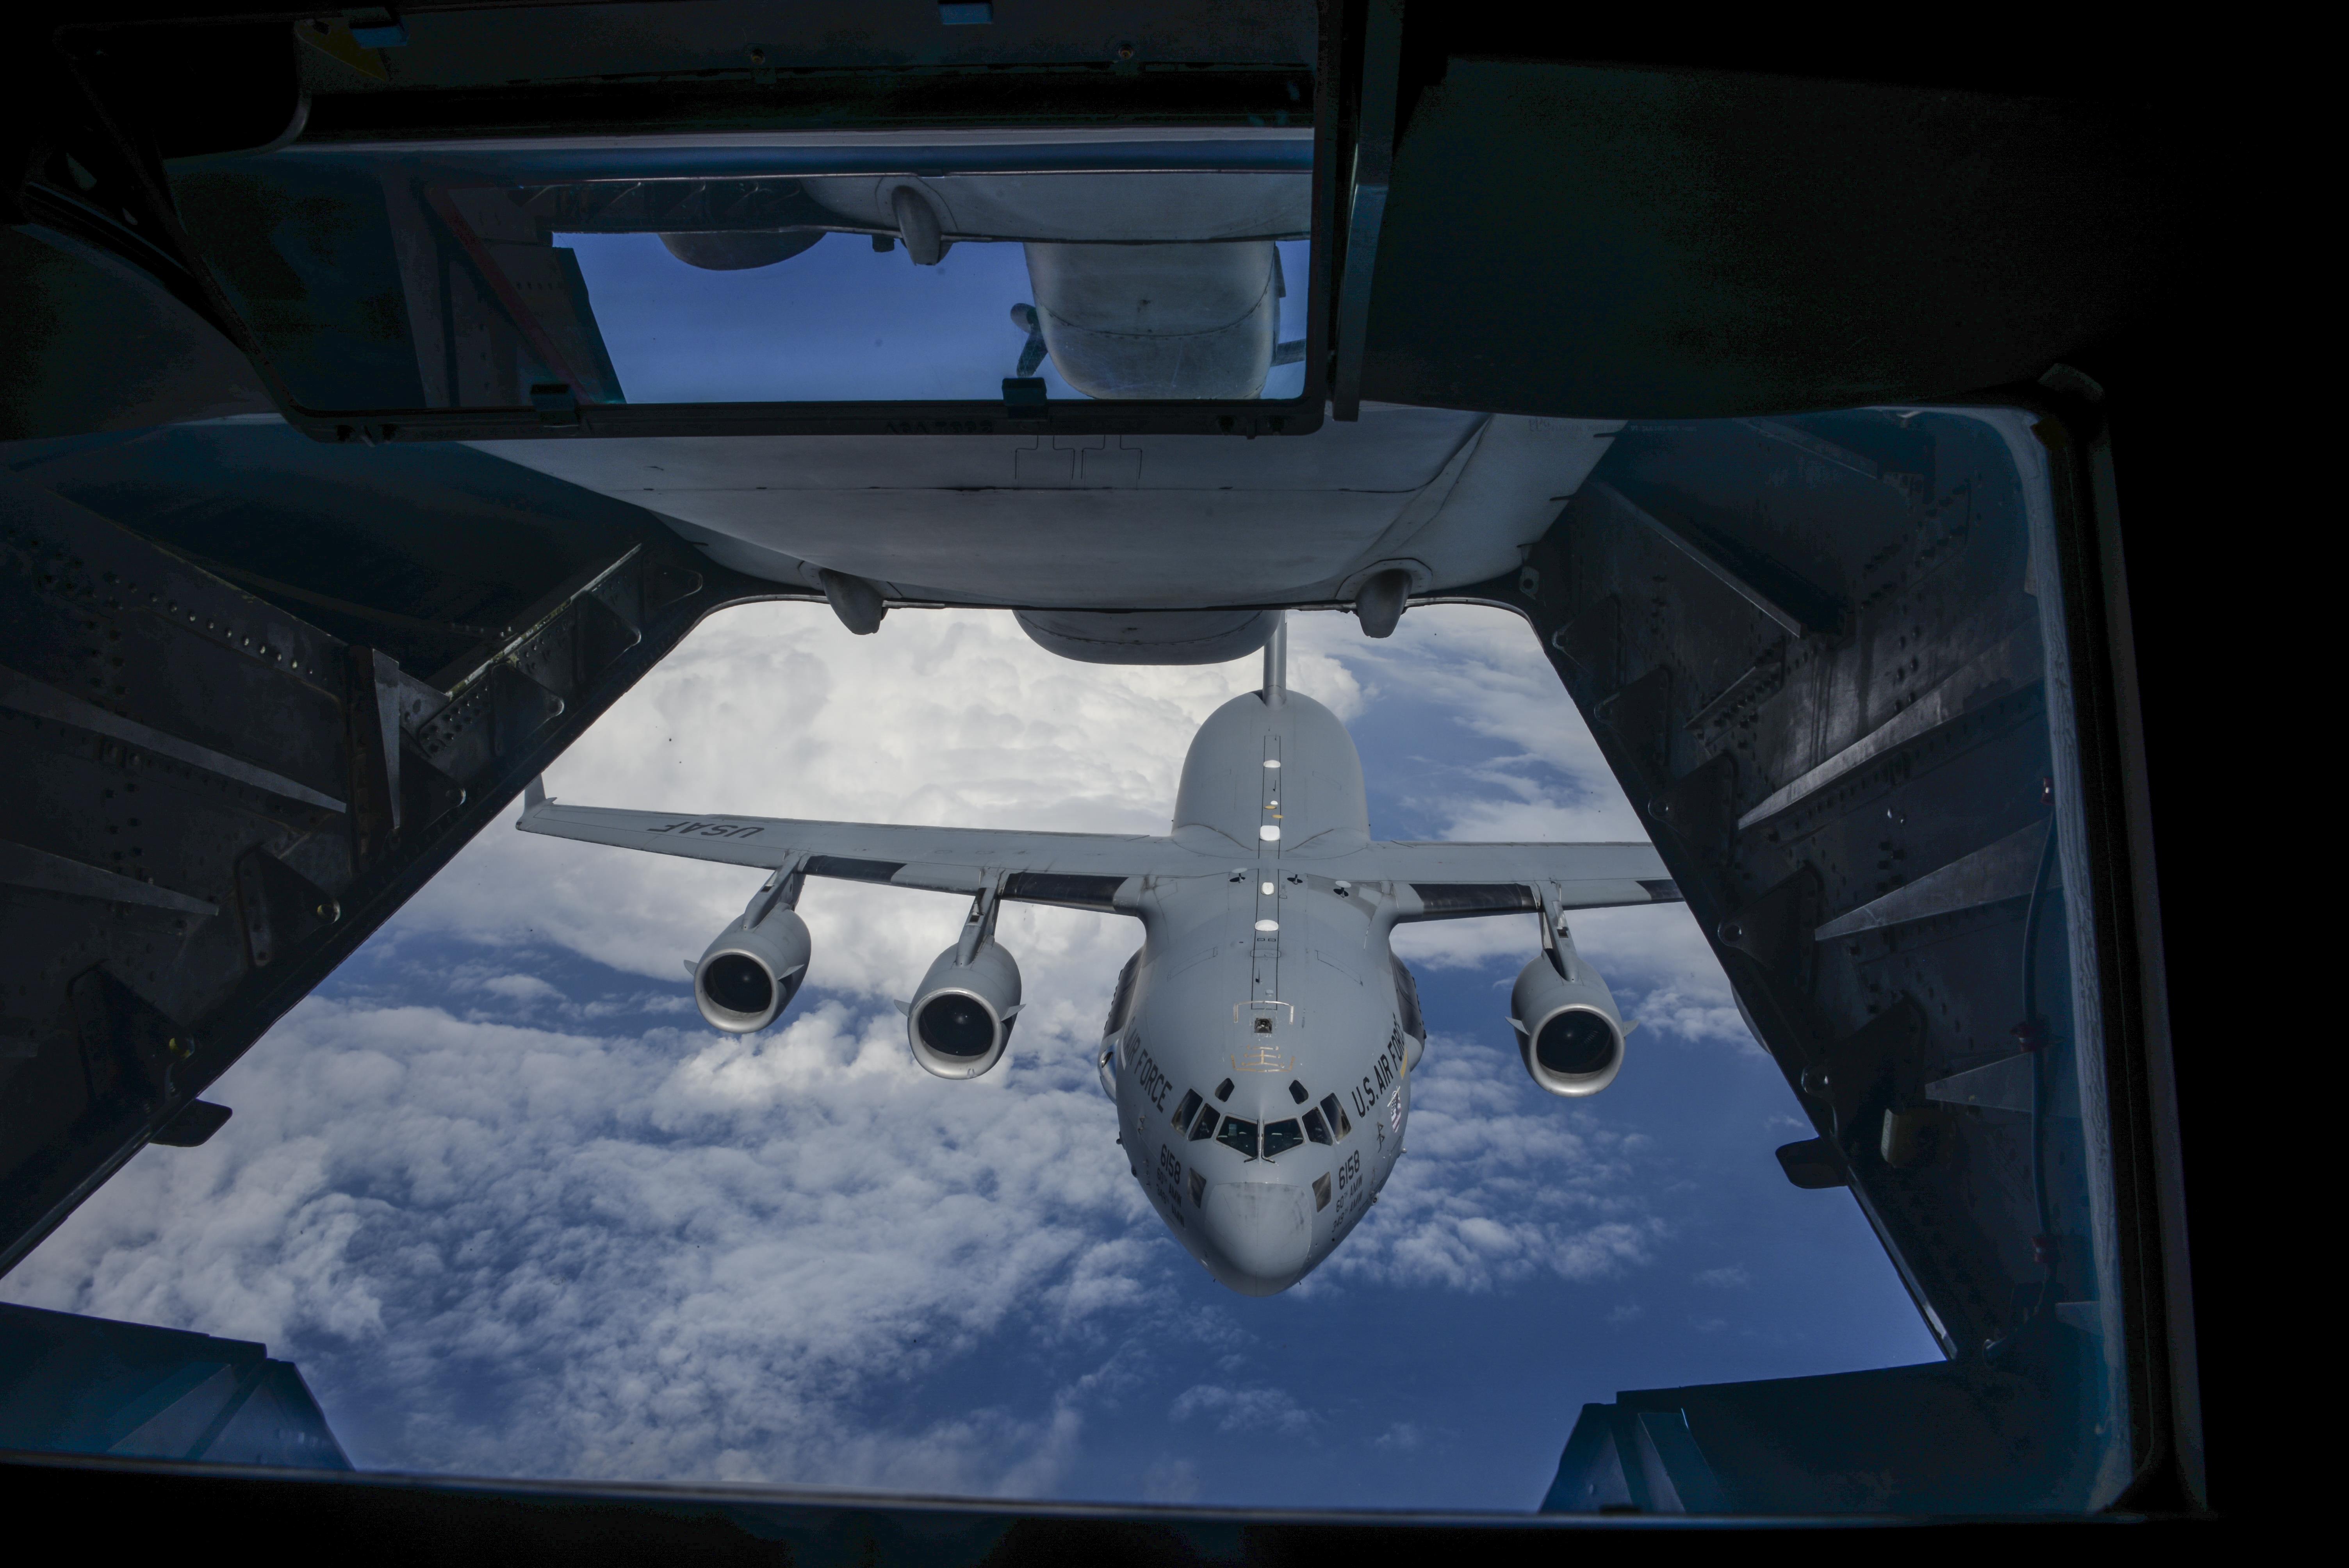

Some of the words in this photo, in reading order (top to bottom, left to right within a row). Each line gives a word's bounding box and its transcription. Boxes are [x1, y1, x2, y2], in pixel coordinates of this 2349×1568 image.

[646, 821, 765, 838] USAF
[1134, 1048, 1173, 1113] FORCE
[1351, 1076, 1379, 1118] U.S.
[1374, 1053, 1393, 1095] AIR
[1160, 1143, 1181, 1185] 6158
[1338, 1149, 1360, 1190] 6158
[1349, 1173, 1363, 1198] AMW
